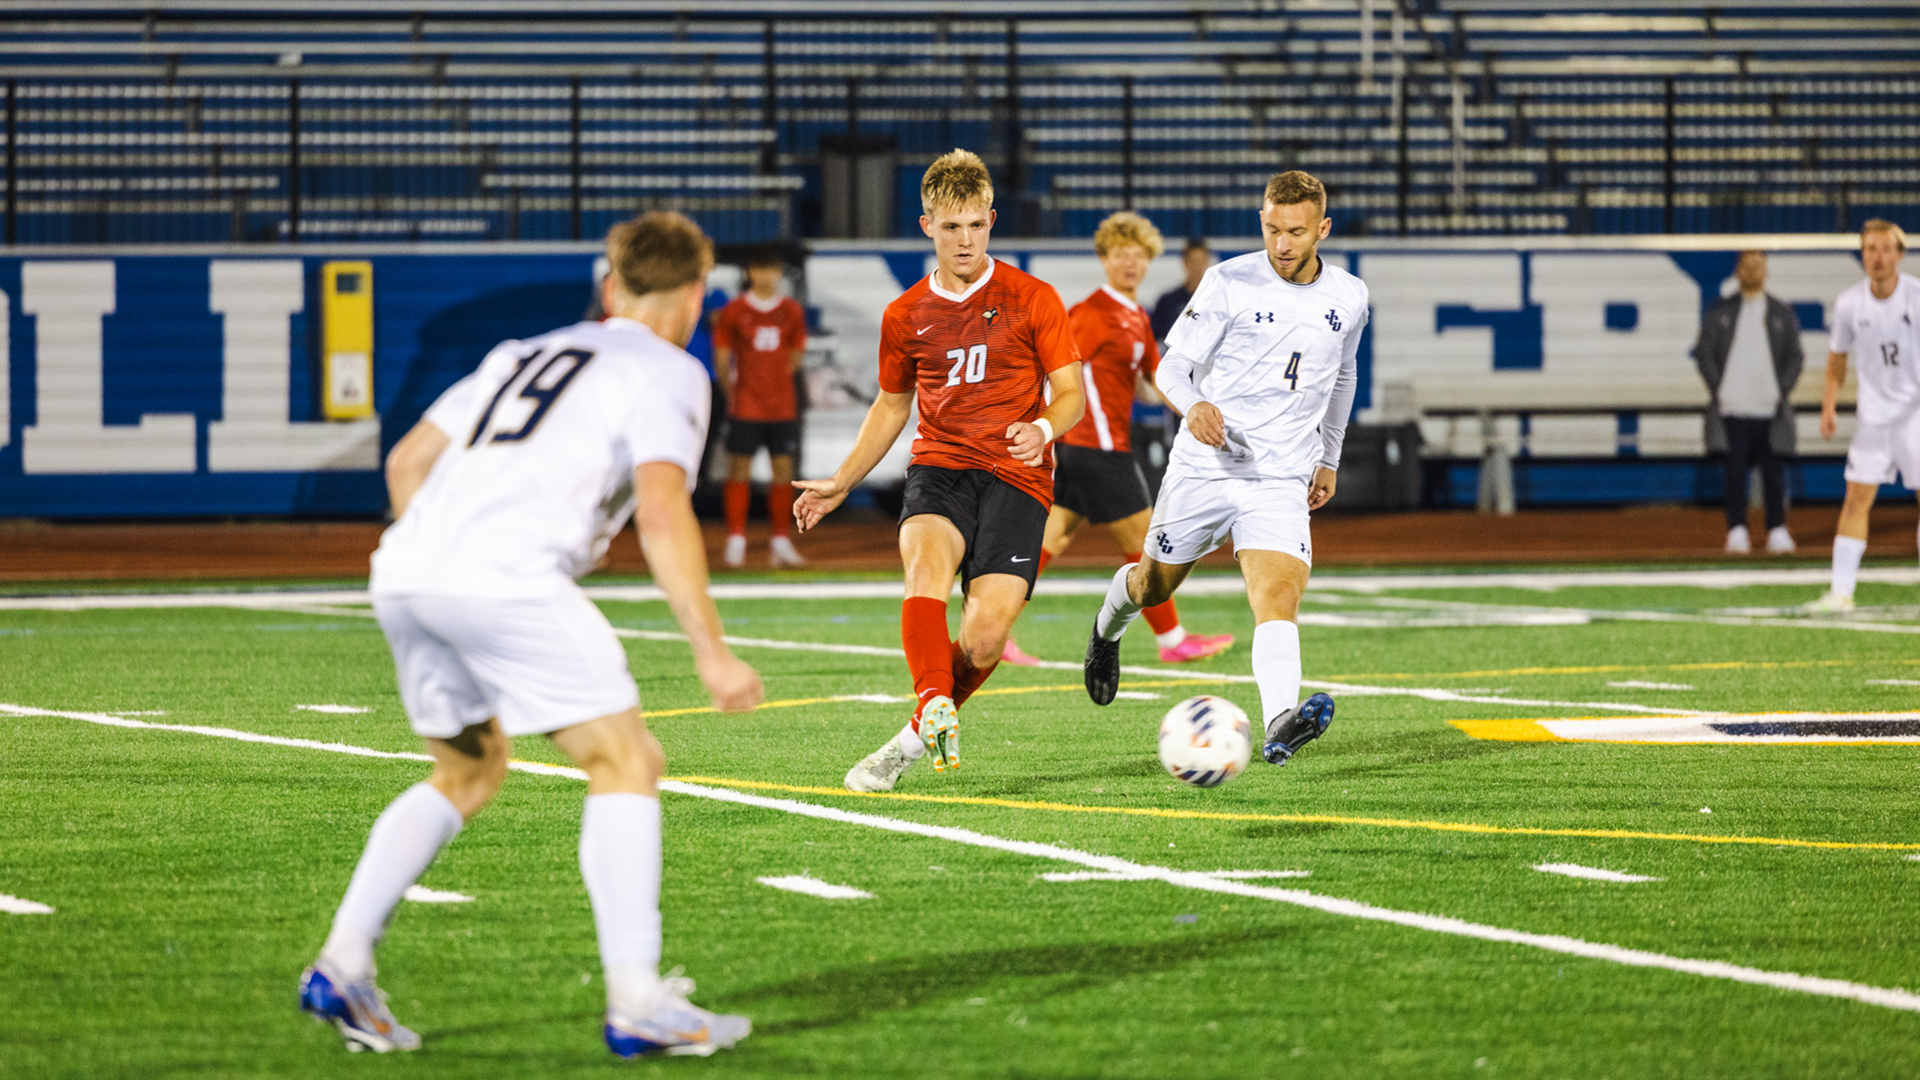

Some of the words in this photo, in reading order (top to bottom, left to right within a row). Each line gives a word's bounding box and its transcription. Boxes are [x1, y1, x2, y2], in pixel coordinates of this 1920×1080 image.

[1324, 309, 1342, 332] JCU
[0, 260, 381, 473] LL
[945, 344, 988, 388] 20
[1283, 351, 1302, 391] 4
[1880, 341, 1899, 366] 12
[465, 348, 595, 449] 19
